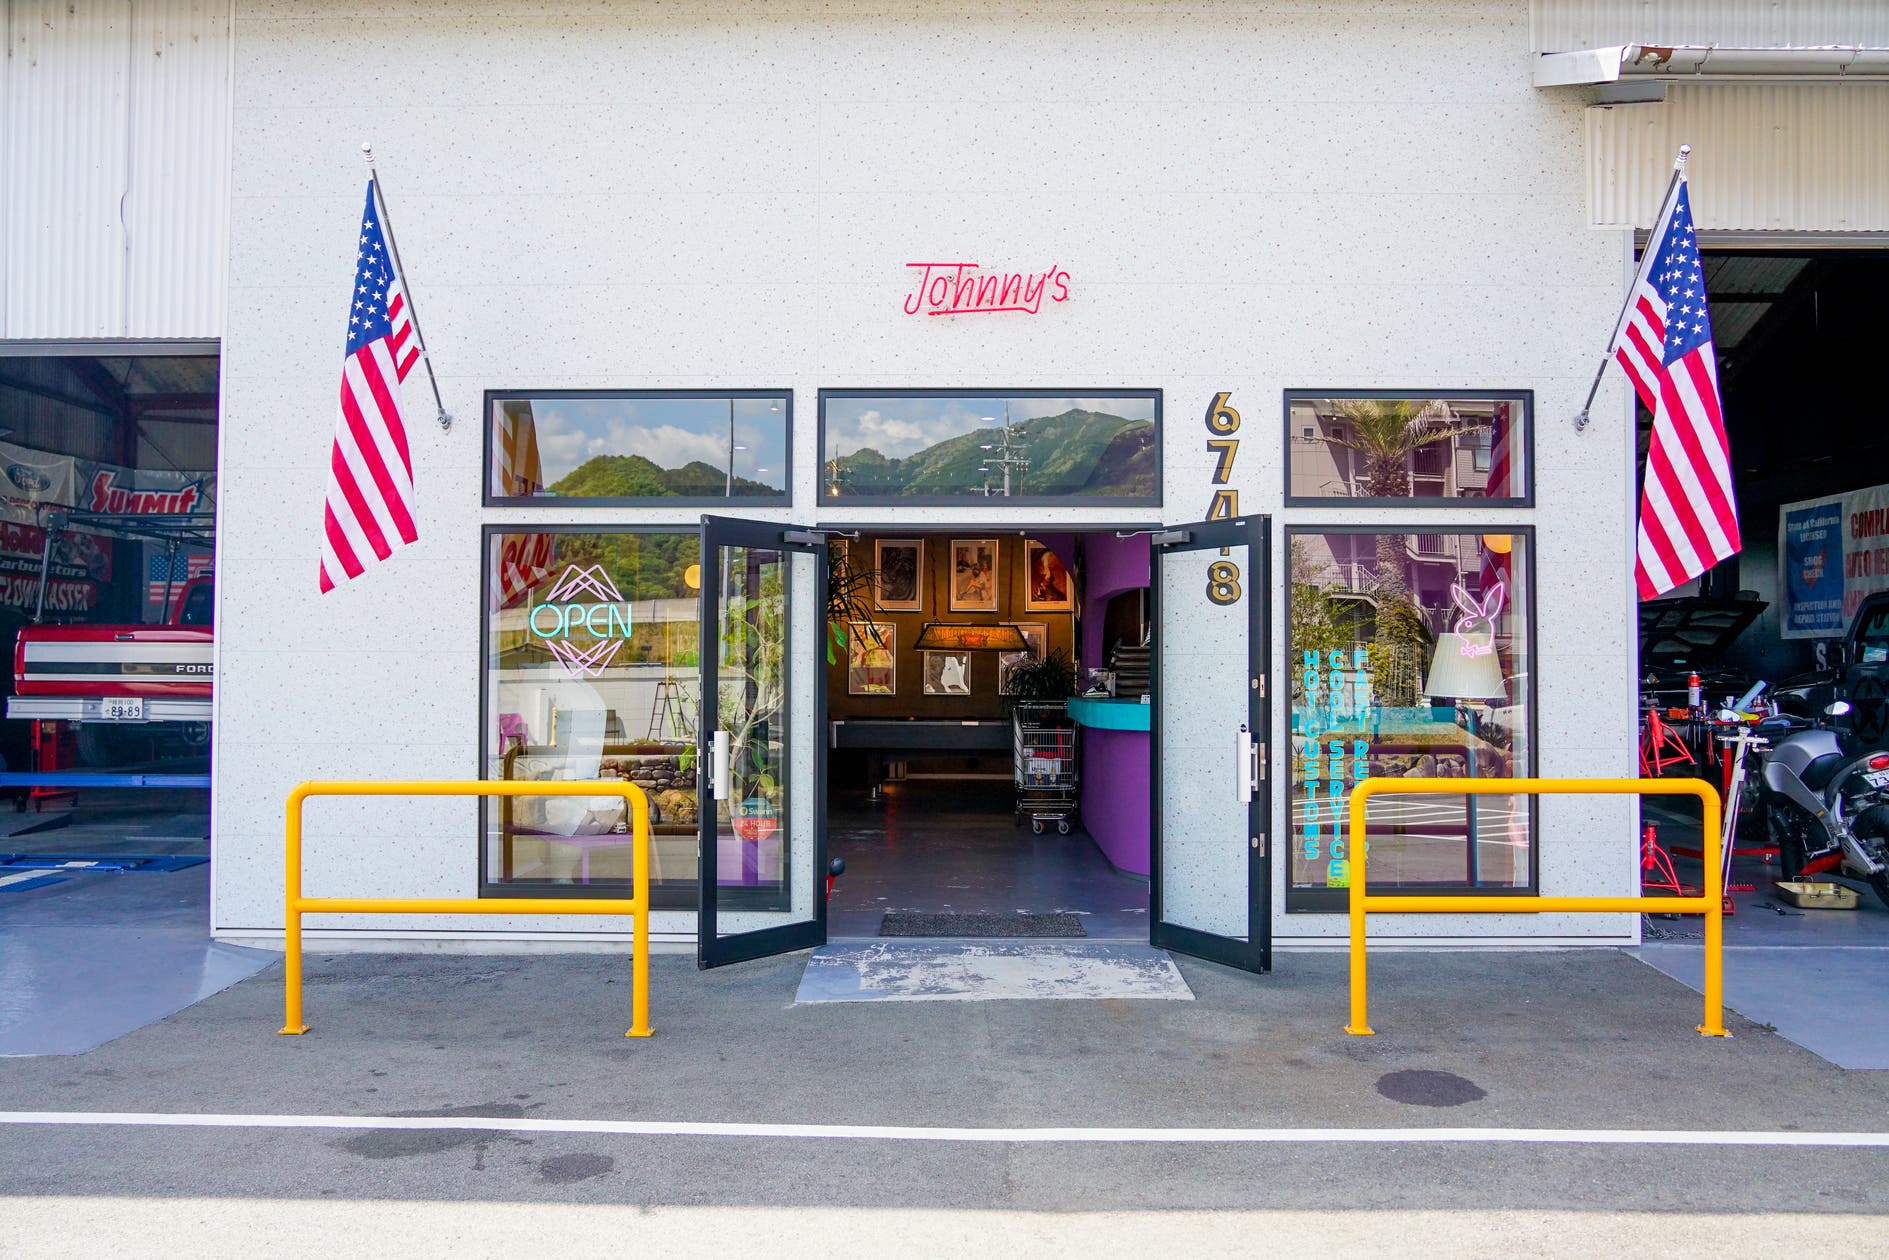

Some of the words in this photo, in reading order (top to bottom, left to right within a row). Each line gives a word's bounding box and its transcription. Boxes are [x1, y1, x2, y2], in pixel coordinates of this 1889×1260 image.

[1204, 391, 1242, 606] 6748
[1850, 508, 1889, 539] COMPL
[529, 603, 632, 638] OPEN
[1304, 650, 1320, 712] HOT
[1329, 650, 1345, 732] COOL
[1354, 650, 1369, 731] FAST
[1304, 720, 1320, 860] CUSTOMS
[1329, 740, 1345, 877] SERVICE
